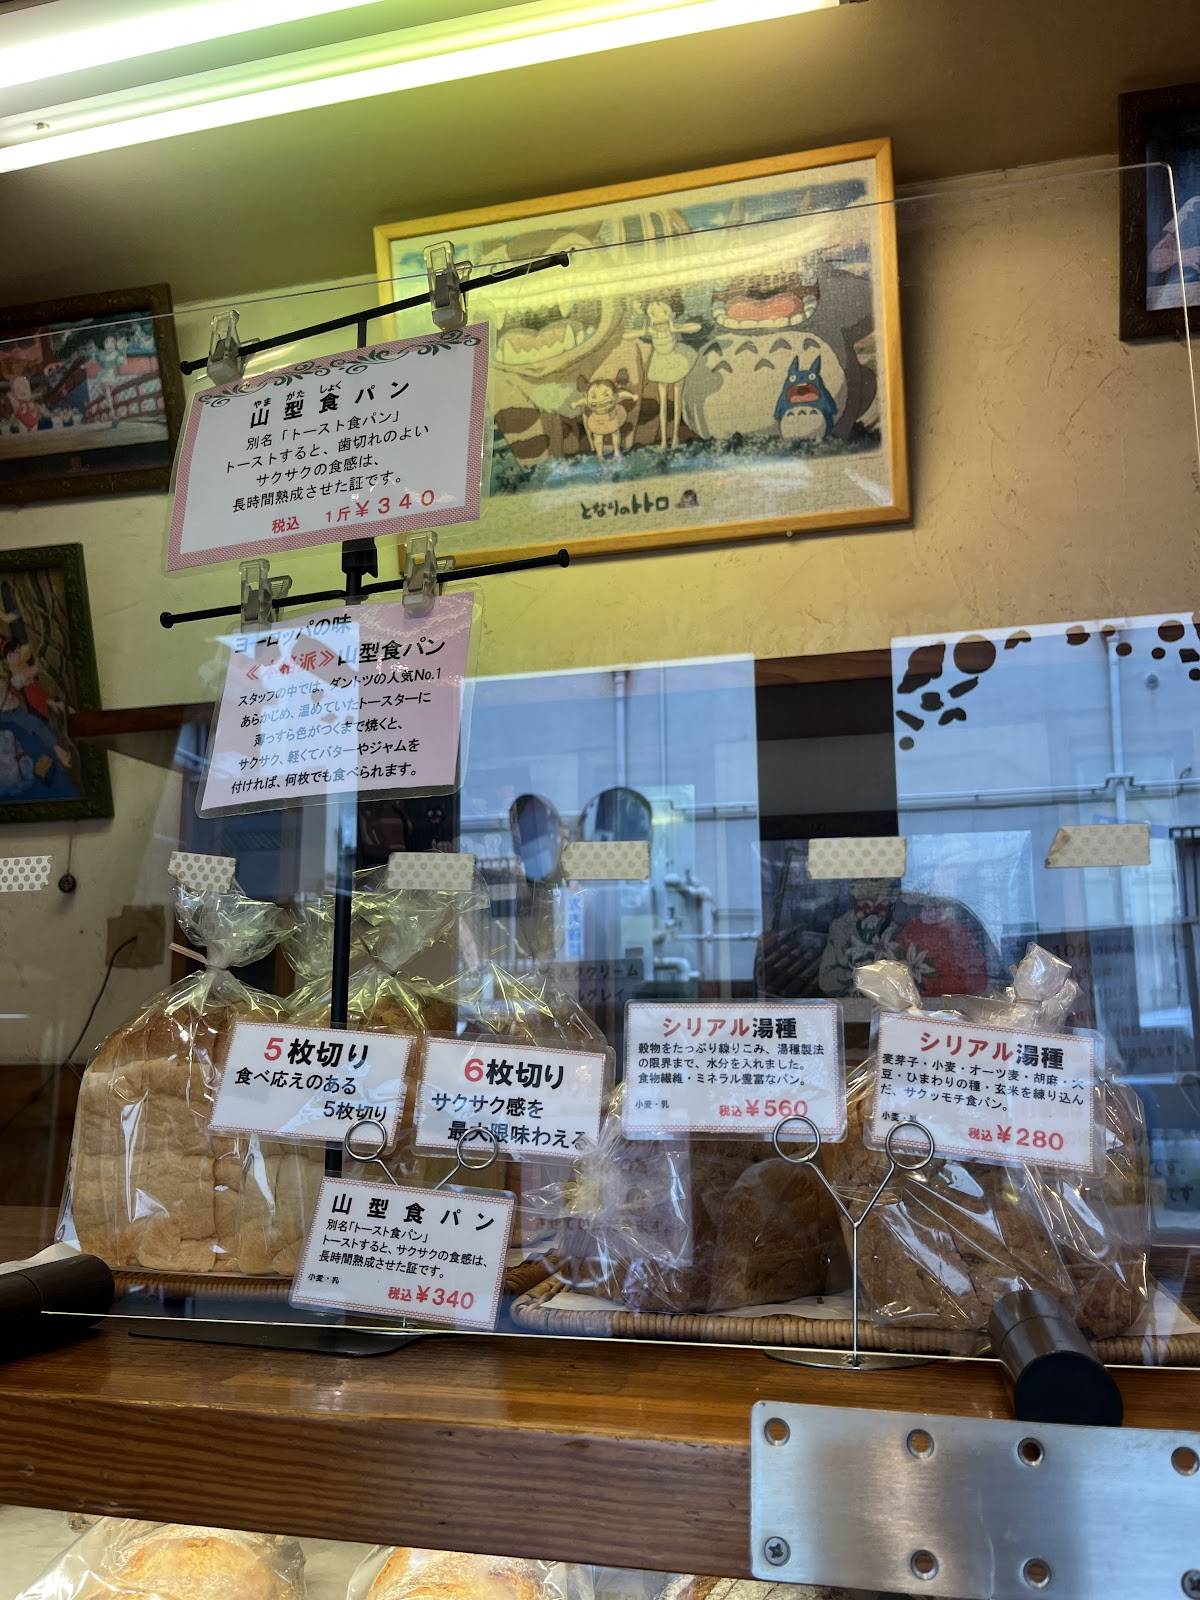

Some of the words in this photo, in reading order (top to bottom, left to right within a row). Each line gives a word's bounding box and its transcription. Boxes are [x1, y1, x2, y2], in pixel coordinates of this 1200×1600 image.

[253, 397, 271, 408] やま
[286, 390, 304, 400] がた
[319, 380, 342, 394] しょく
[246, 411, 400, 451] 別名「トースト食パン」
[226, 424, 429, 473] トーストすると、歯切れのよい
[255, 454, 380, 486] サクサクの食感は、
[232, 472, 402, 513] 長時間熟成させた証です。
[581, 492, 669, 519] となりのトトロ
[271, 517, 300, 533] 税込
[234, 614, 352, 653] ヨーロッパの味
[337, 636, 445, 666] 山型食パン
[240, 692, 432, 727] あらかじめ、温めていたトースターに
[238, 738, 421, 771] サクサク、軽くてバターやジャムを
[231, 763, 417, 794] 付ければ、何枚でも食べられます。
[662, 1017, 798, 1039] シリアル湯種
[263, 1037, 369, 1070] 5枚切り
[638, 1042, 825, 1056] 穀物をたっぷり練りこみ、湯種製法
[920, 1032, 1064, 1070] シリアル湯種
[464, 1058, 564, 1090] 6枚切り
[638, 1058, 805, 1071] の限界まで、水分を入れました。
[638, 1072, 805, 1086] 食物繊維・ミネラル豊富なパン。
[235, 1067, 357, 1095] 食べ応えのある
[880, 1069, 1084, 1105] 豆・ひまわりの種・玄米を練り込ん
[323, 1101, 387, 1122] 5枚切り
[431, 1092, 544, 1119] サクサク感を
[880, 1084, 1008, 1112] だ、サクッモチ食パン。
[325, 1219, 429, 1244] 別名「トースト食パン」
[318, 1249, 444, 1278] 長時間熟成させた証です。
[322, 1234, 487, 1268] トーストすると、サクサクの食感は、
